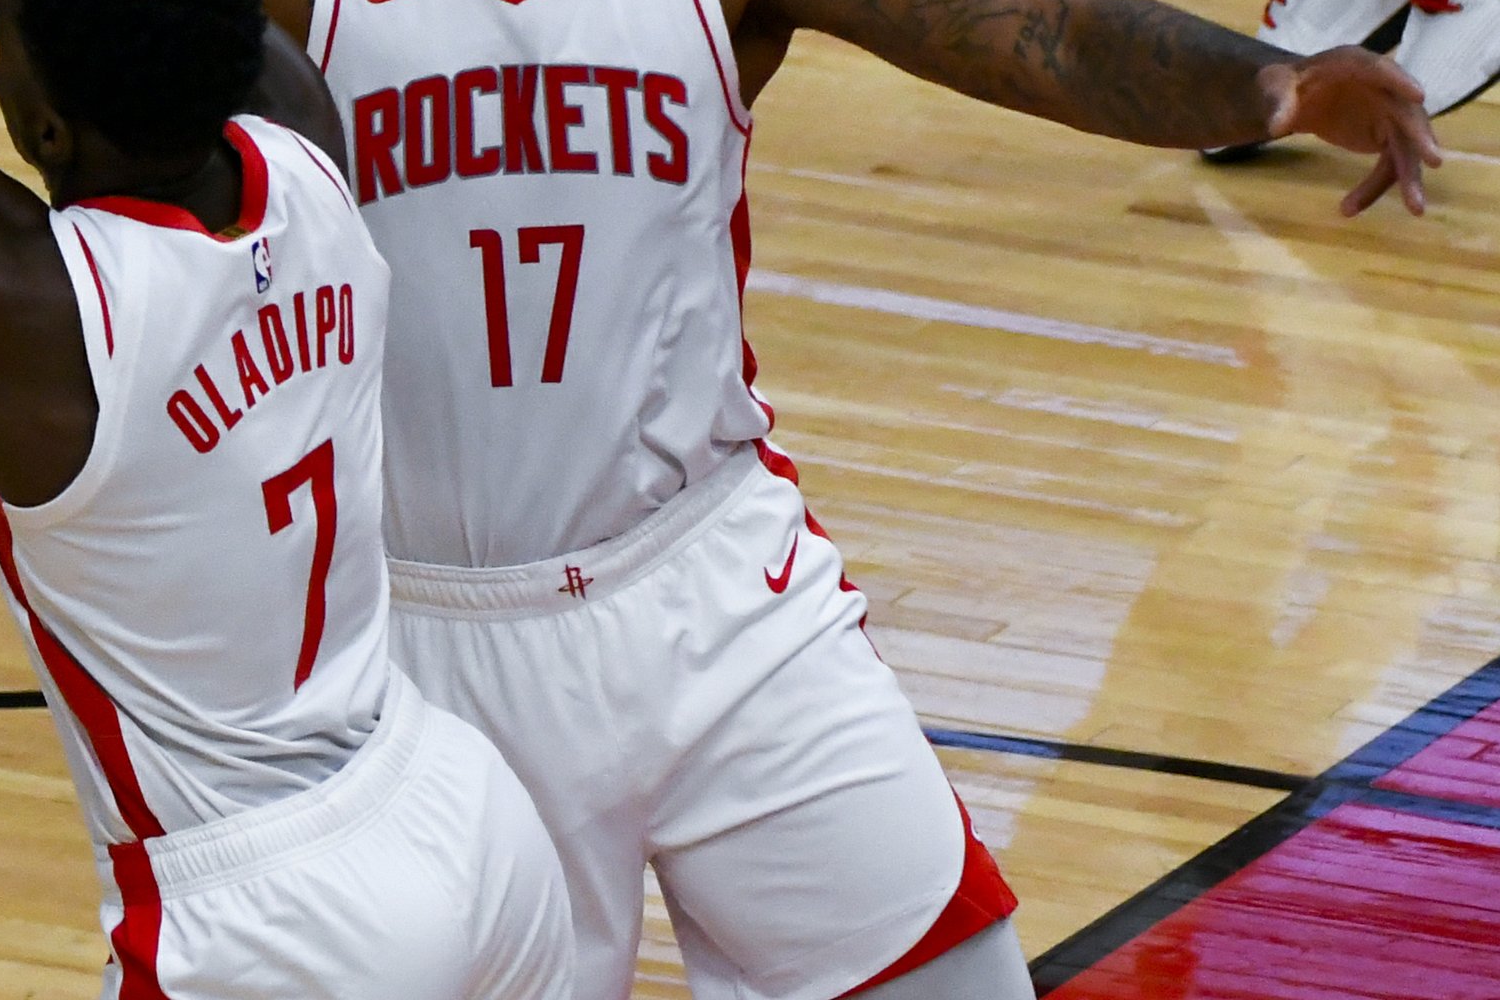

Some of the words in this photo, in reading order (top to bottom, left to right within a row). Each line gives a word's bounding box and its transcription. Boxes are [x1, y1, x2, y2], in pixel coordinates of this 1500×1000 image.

[352, 64, 690, 208] ROCKETS
[166, 283, 355, 454] OLADIPO
[469, 224, 586, 388] 17
[262, 437, 337, 694] 7
